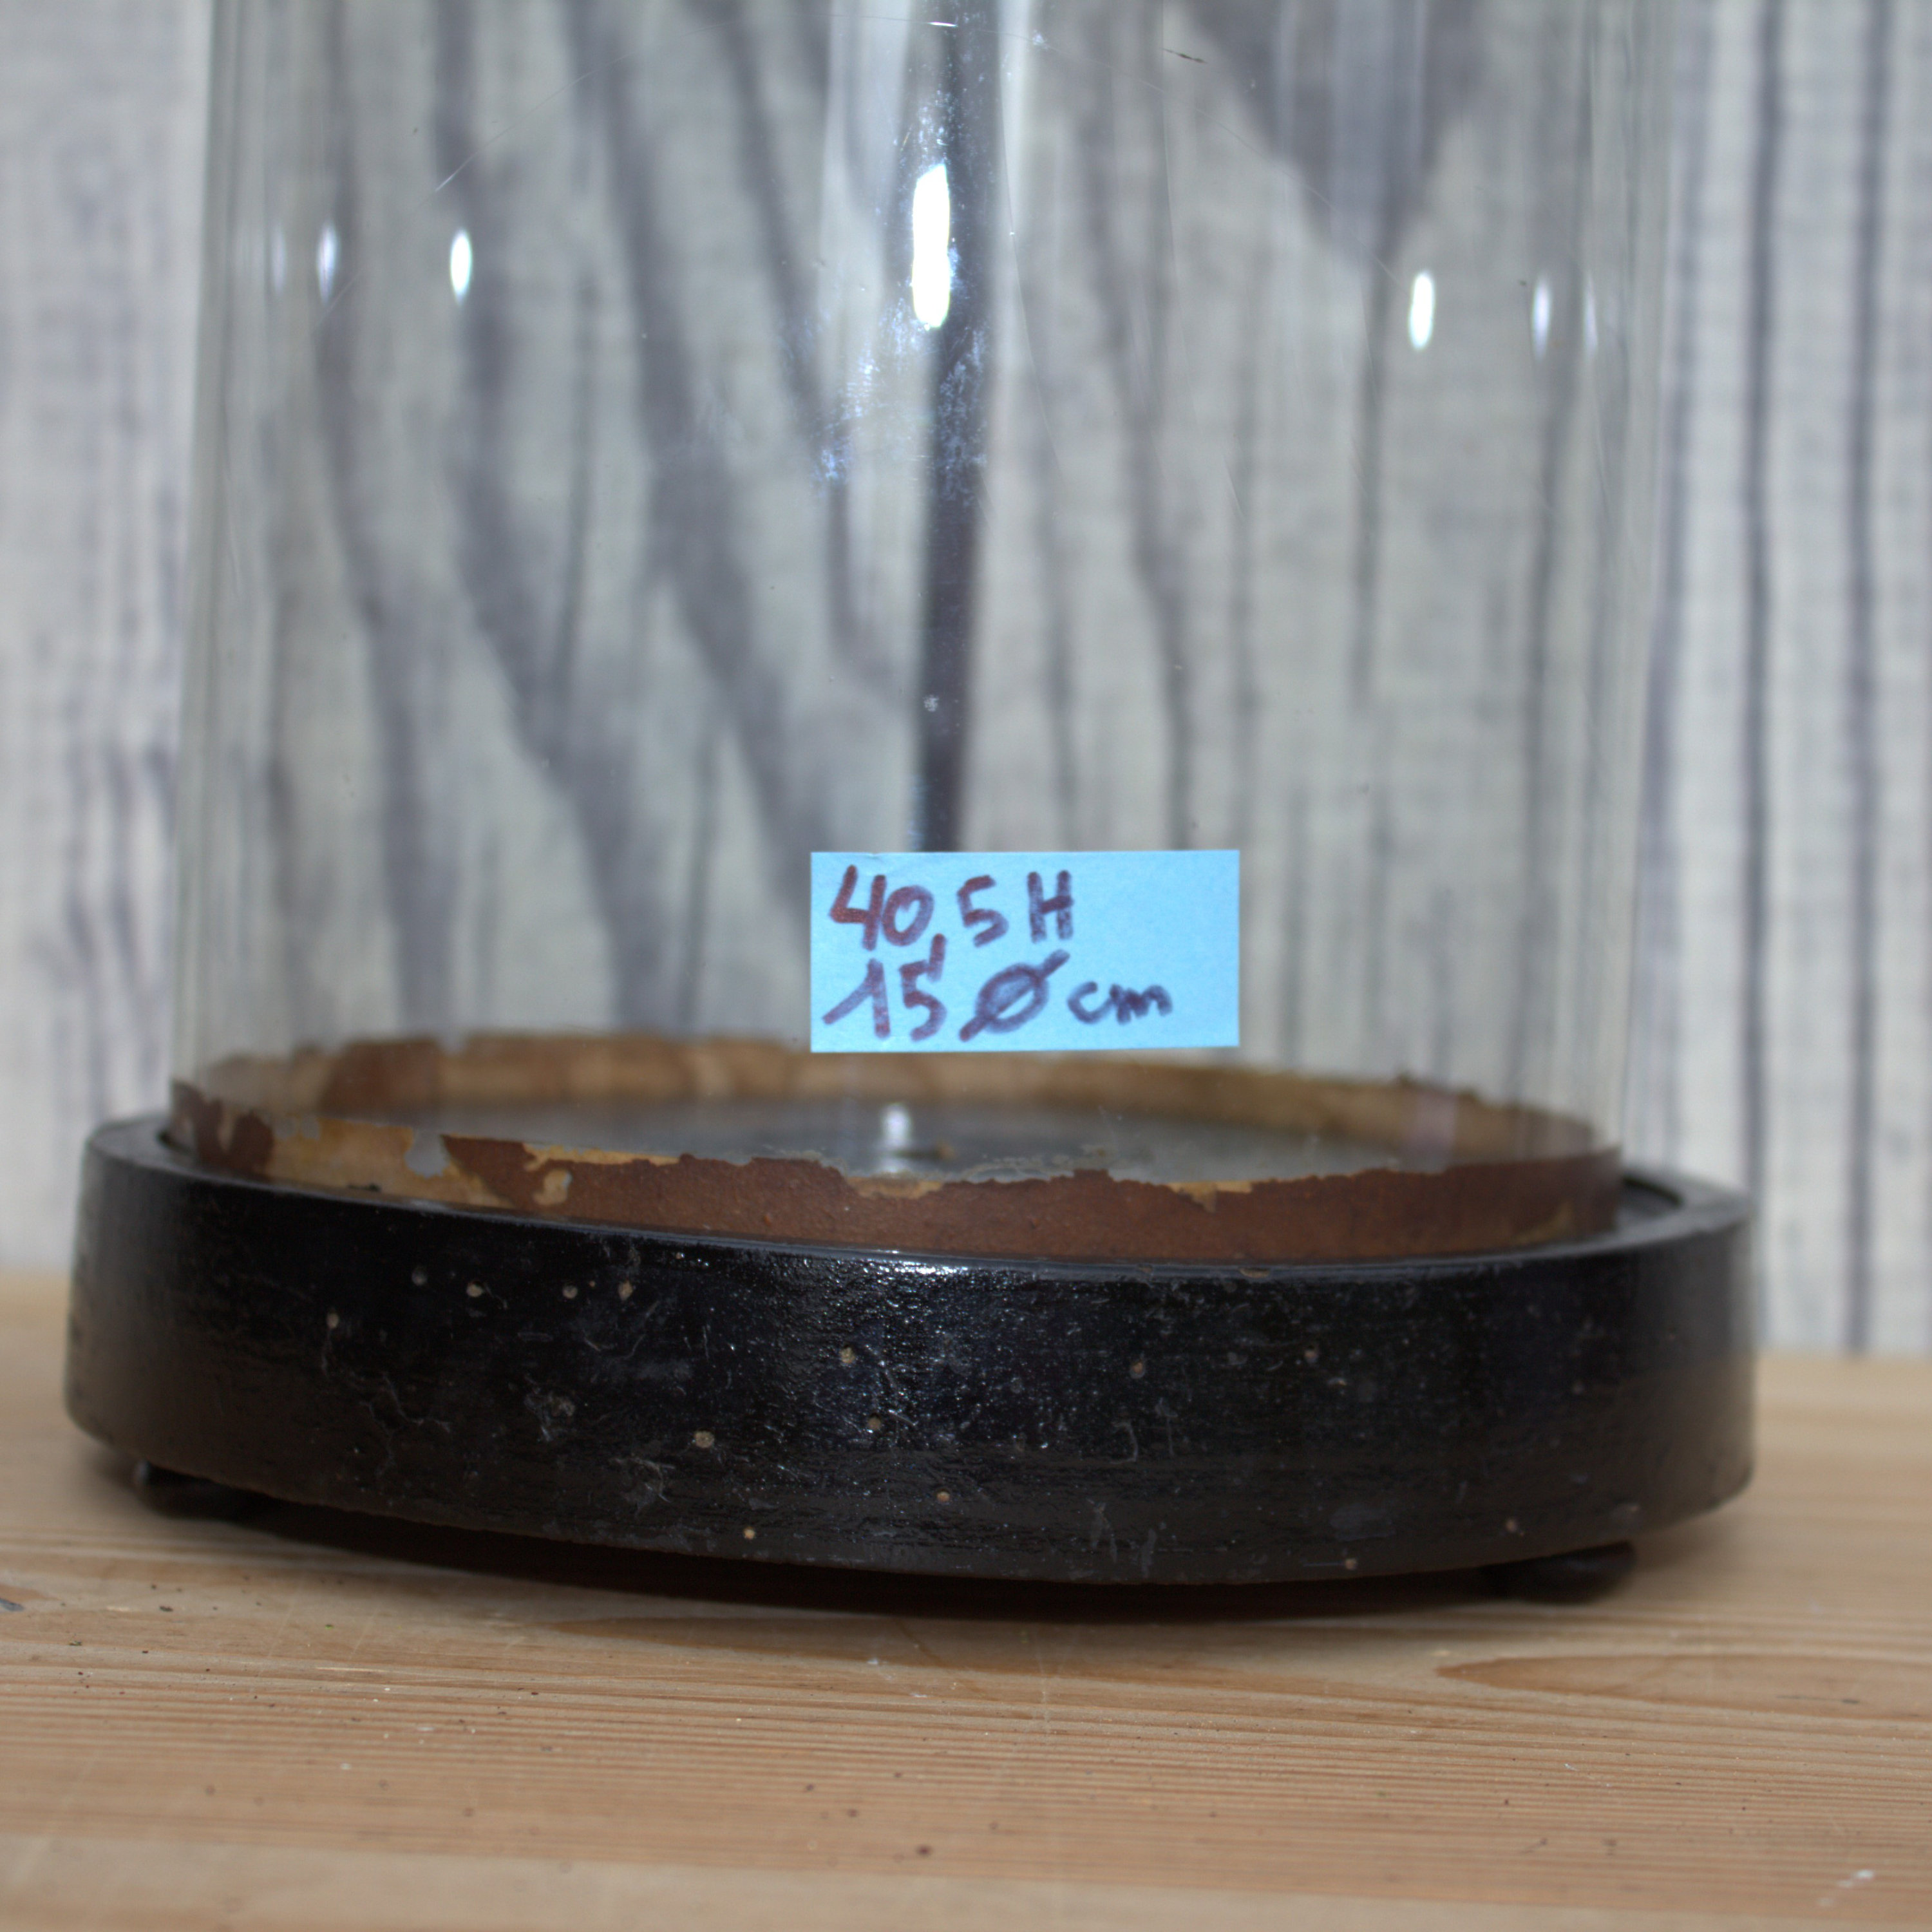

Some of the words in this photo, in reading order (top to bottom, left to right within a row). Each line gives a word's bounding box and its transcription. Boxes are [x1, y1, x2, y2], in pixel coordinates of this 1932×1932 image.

[1027, 869, 1074, 943] H
[822, 958, 947, 1042] 15
[1067, 980, 1173, 1025] cm
